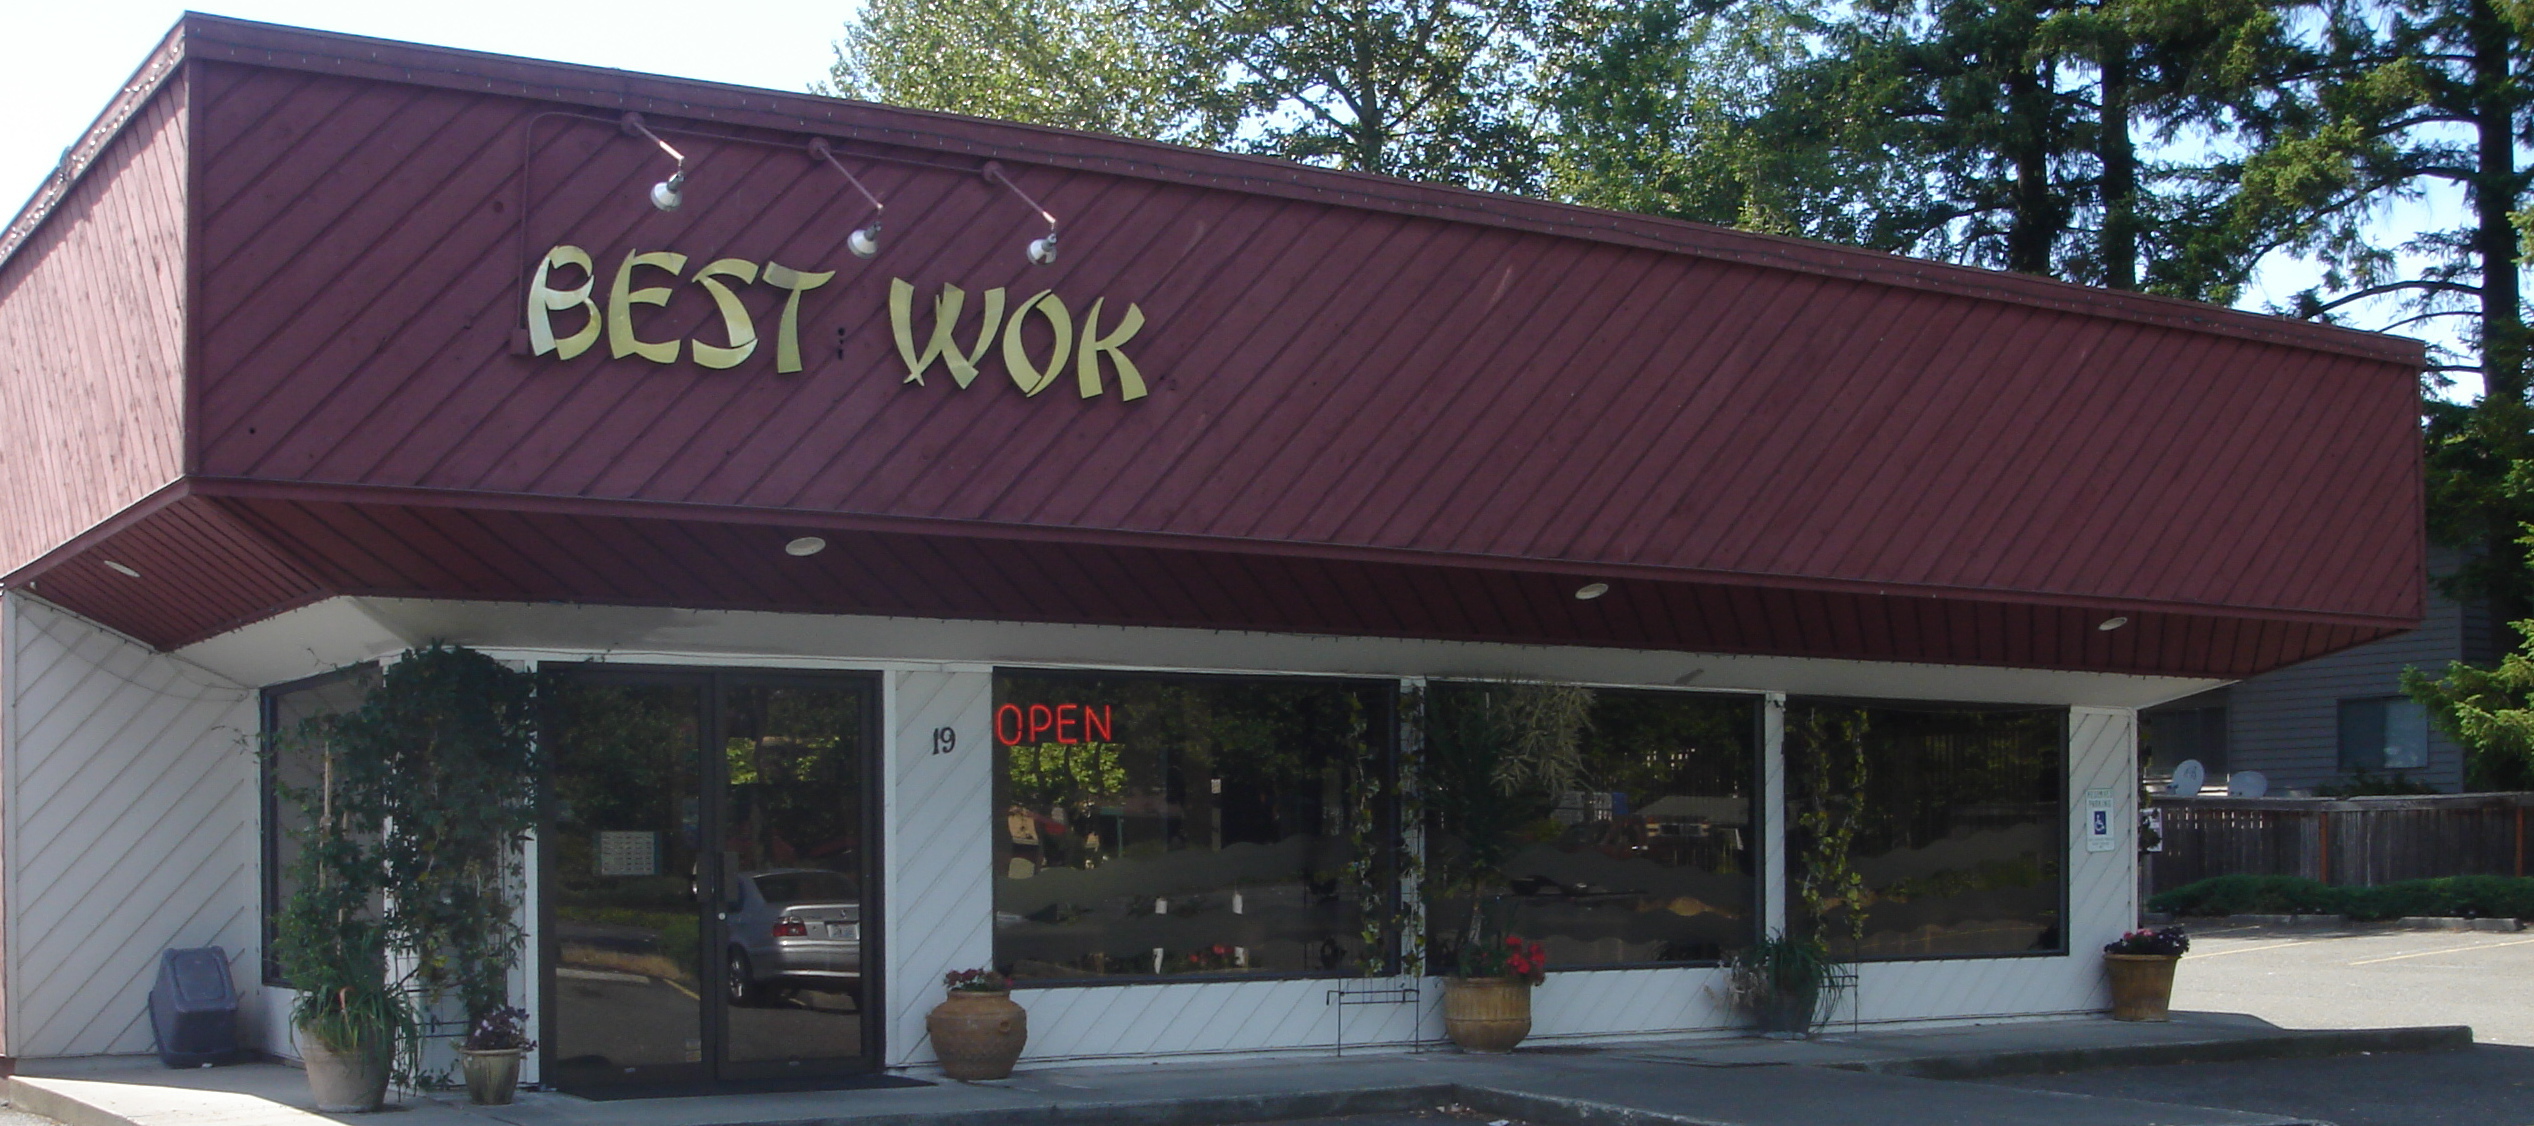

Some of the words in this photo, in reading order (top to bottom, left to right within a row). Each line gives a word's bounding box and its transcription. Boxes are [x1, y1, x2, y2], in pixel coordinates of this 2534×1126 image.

[527, 245, 836, 374] BEST
[889, 276, 1148, 402] WOK
[932, 727, 956, 755] 19
[995, 703, 1113, 745] OPEN
